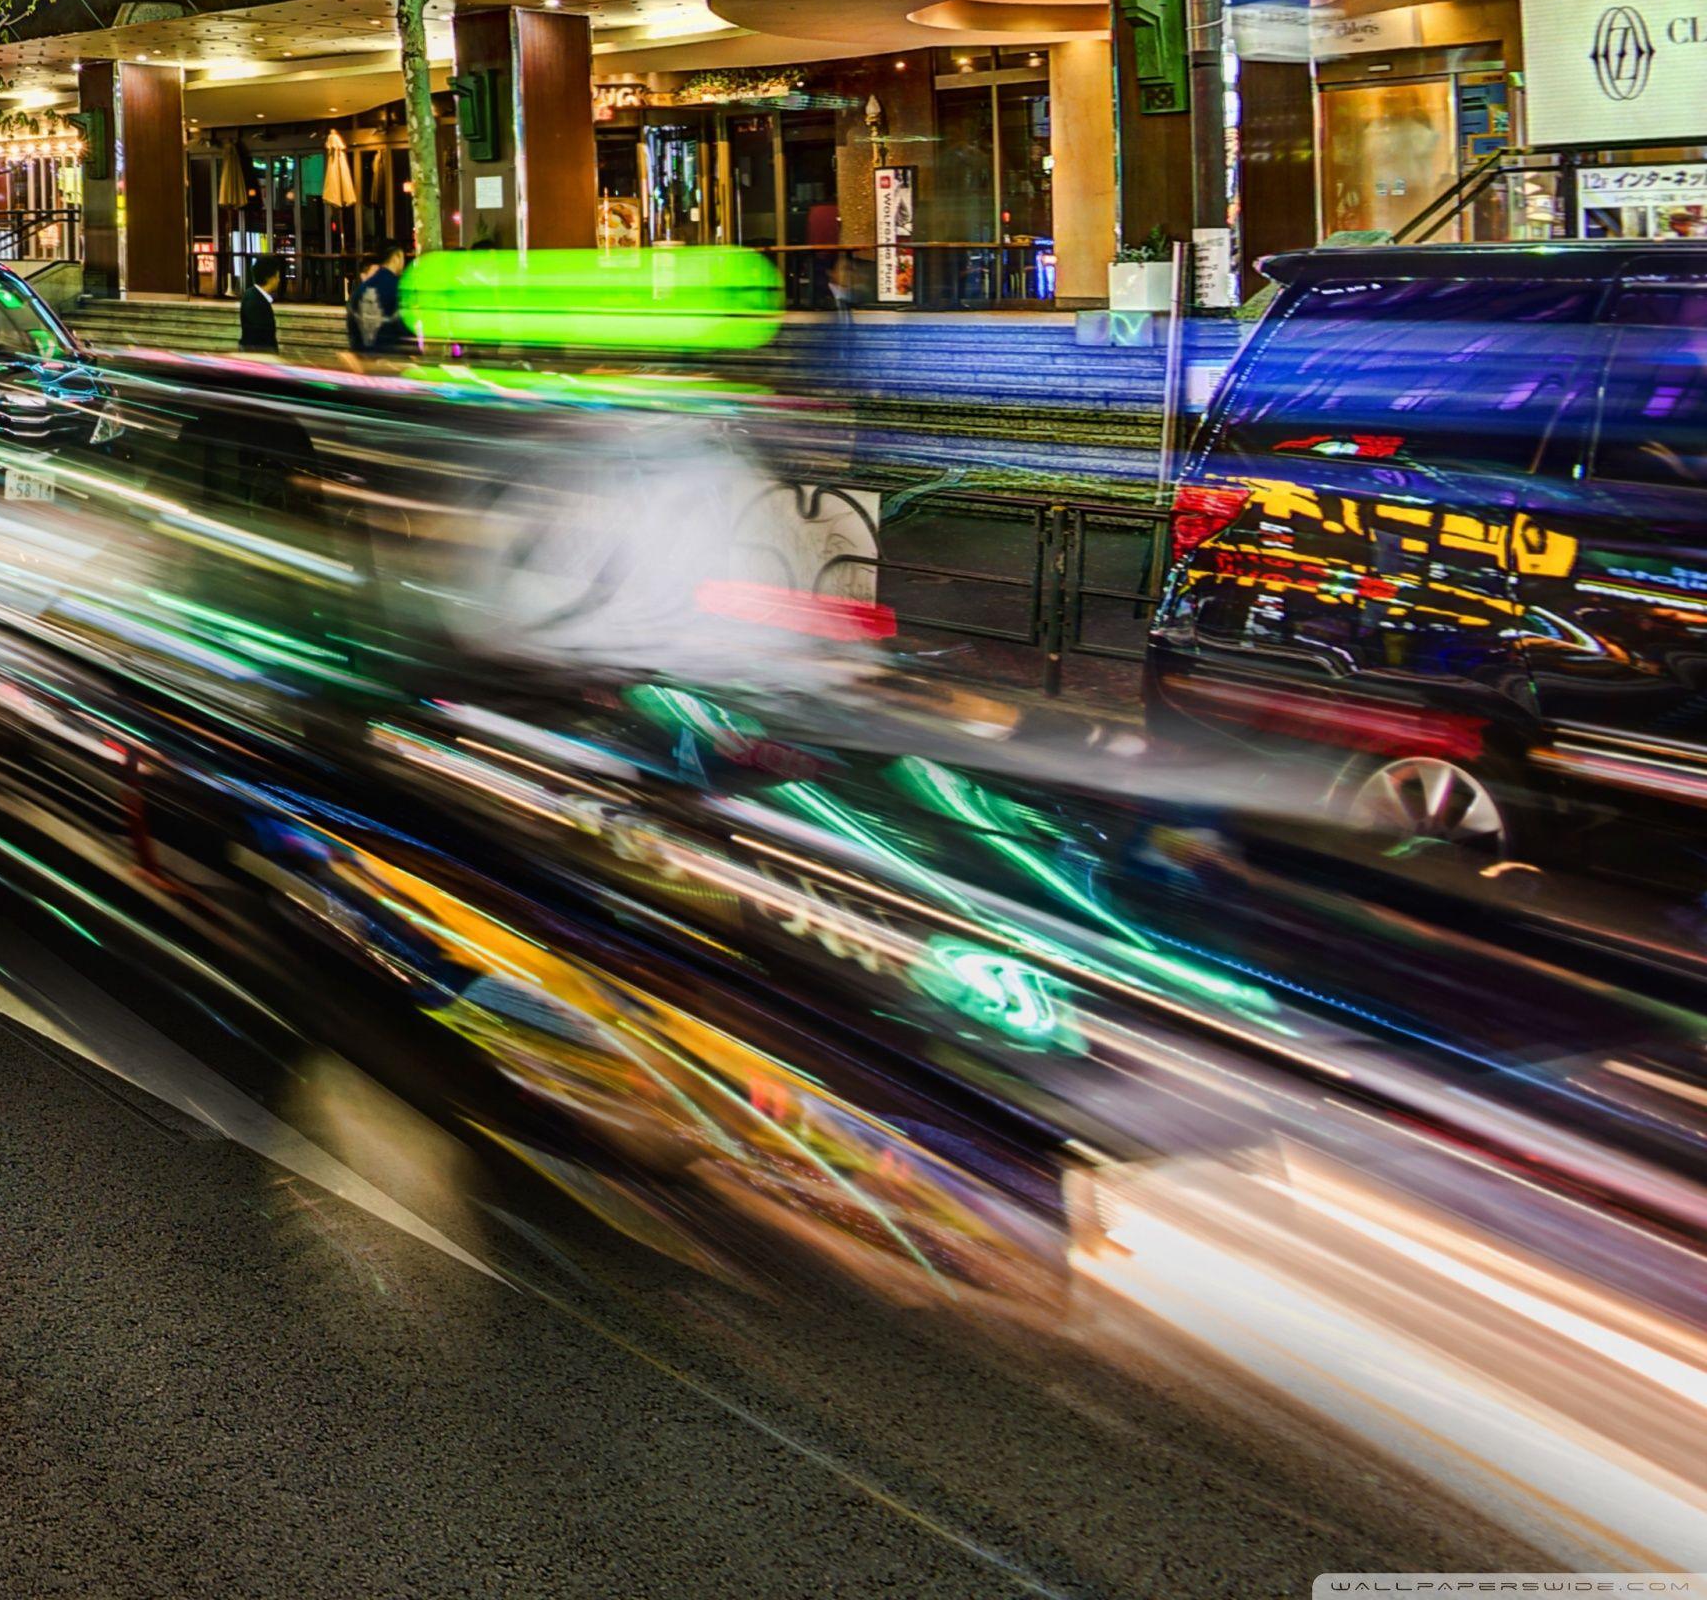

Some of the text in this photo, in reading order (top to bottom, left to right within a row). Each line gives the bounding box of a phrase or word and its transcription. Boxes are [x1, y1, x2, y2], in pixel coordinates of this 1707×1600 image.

[1613, 166, 1707, 190] インターネッ
